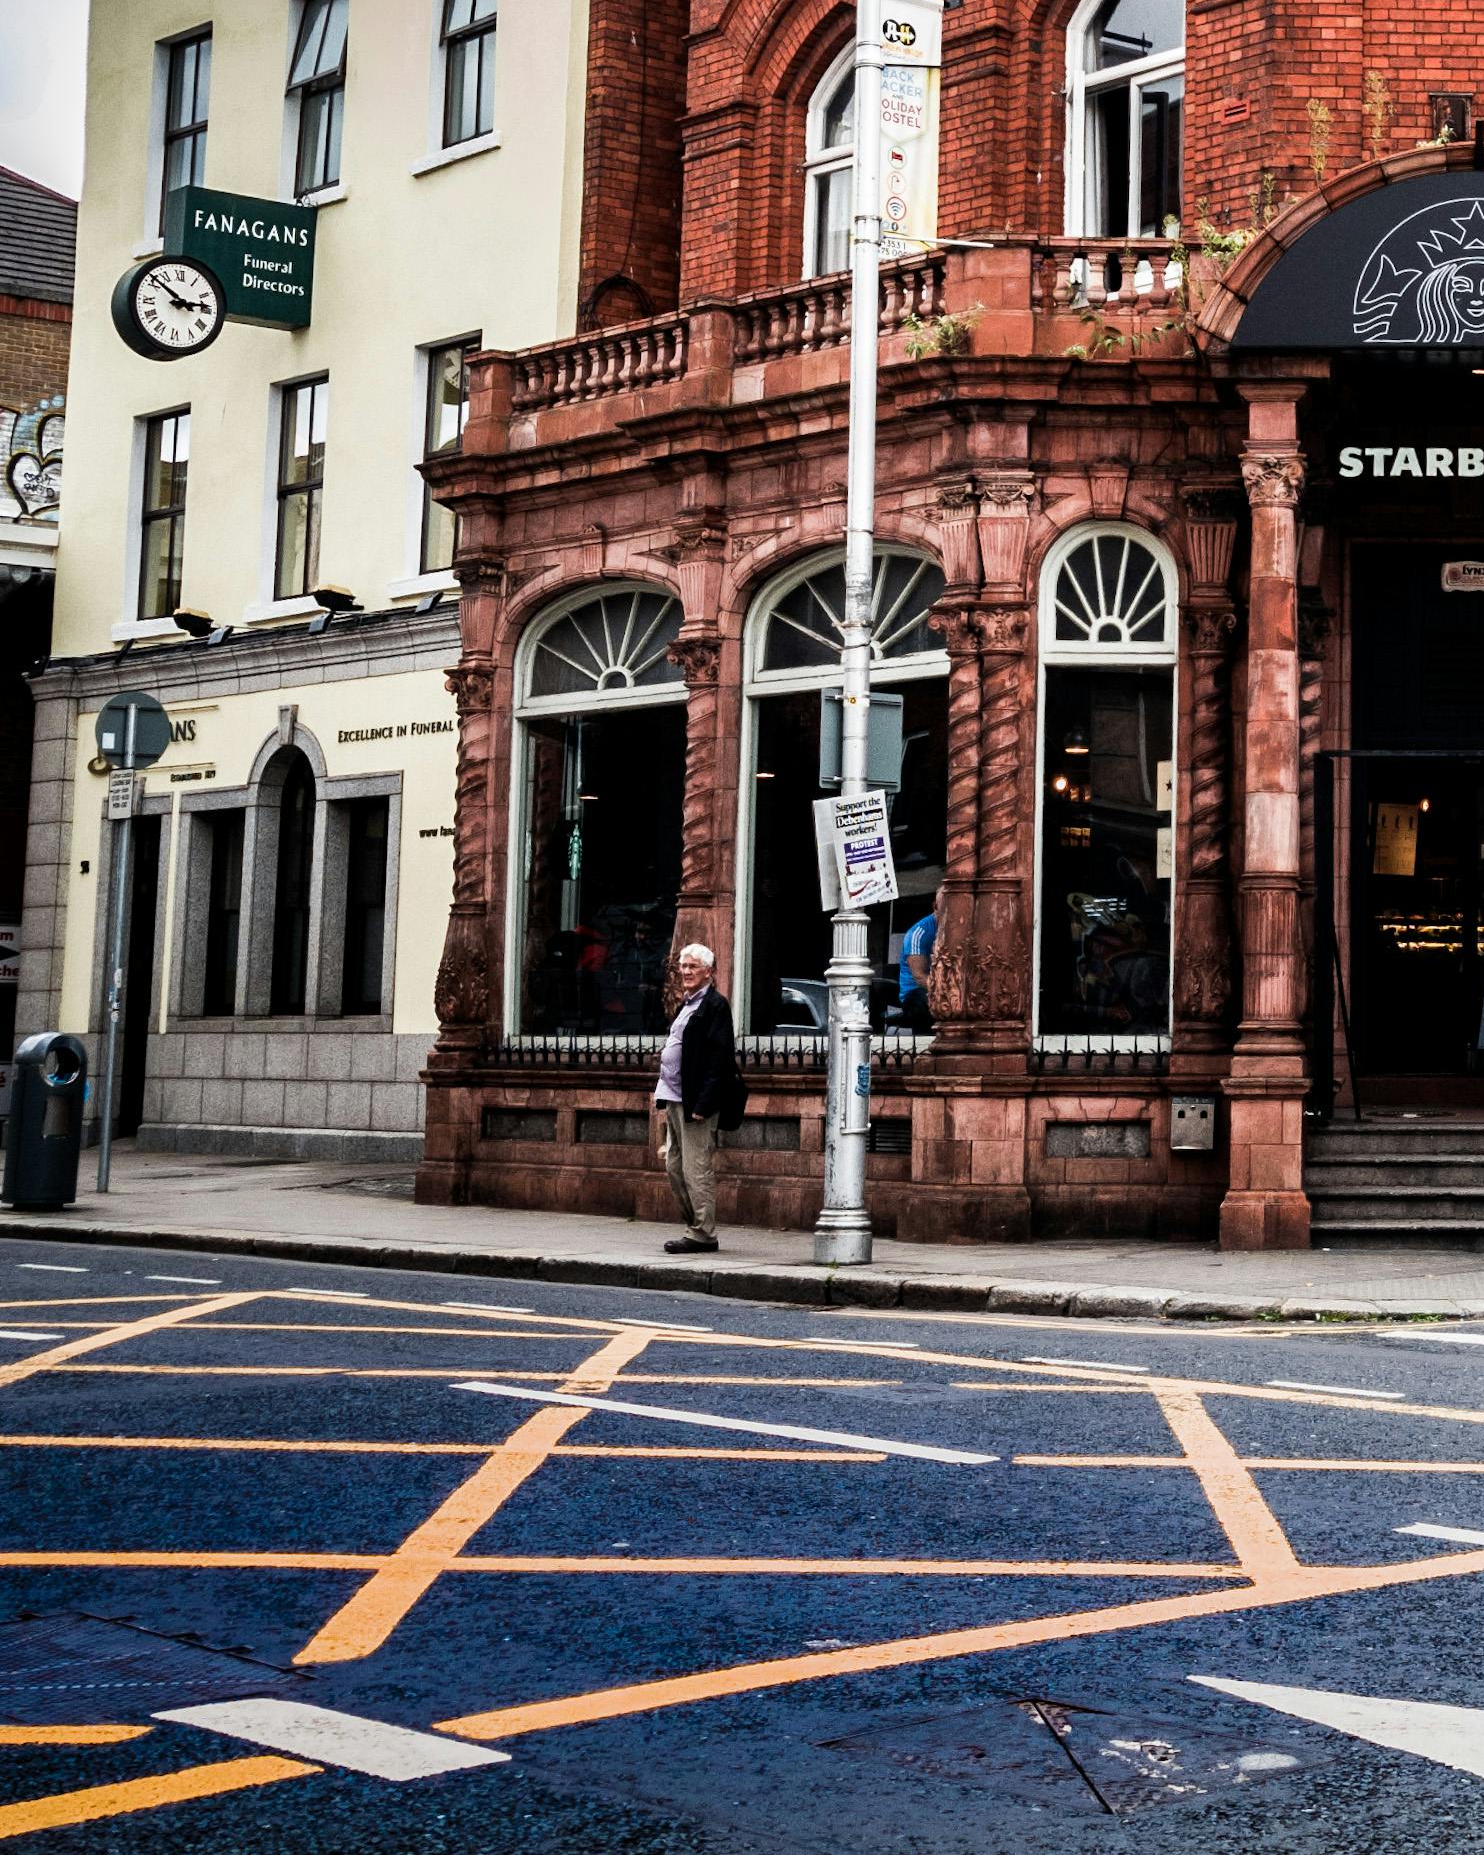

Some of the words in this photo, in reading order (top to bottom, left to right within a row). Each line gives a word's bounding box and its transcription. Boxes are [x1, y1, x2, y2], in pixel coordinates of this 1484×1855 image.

[882, 67, 914, 83] BACK
[881, 81, 922, 98] ACKER
[881, 98, 922, 116] OLIDAY
[882, 111, 921, 129] OSTEL
[194, 209, 308, 247] FANAGANS
[244, 253, 293, 275] Funeral
[174, 269, 185, 282] XII
[242, 273, 305, 297] Directors
[338, 726, 393, 744] EXCELLENCE
[396, 725, 407, 737] IN
[410, 720, 454, 736] FUNERAL
[836, 799, 867, 814] Support
[868, 797, 881, 806] the
[845, 822, 877, 837] workers!
[850, 838, 878, 851] PROTEST
